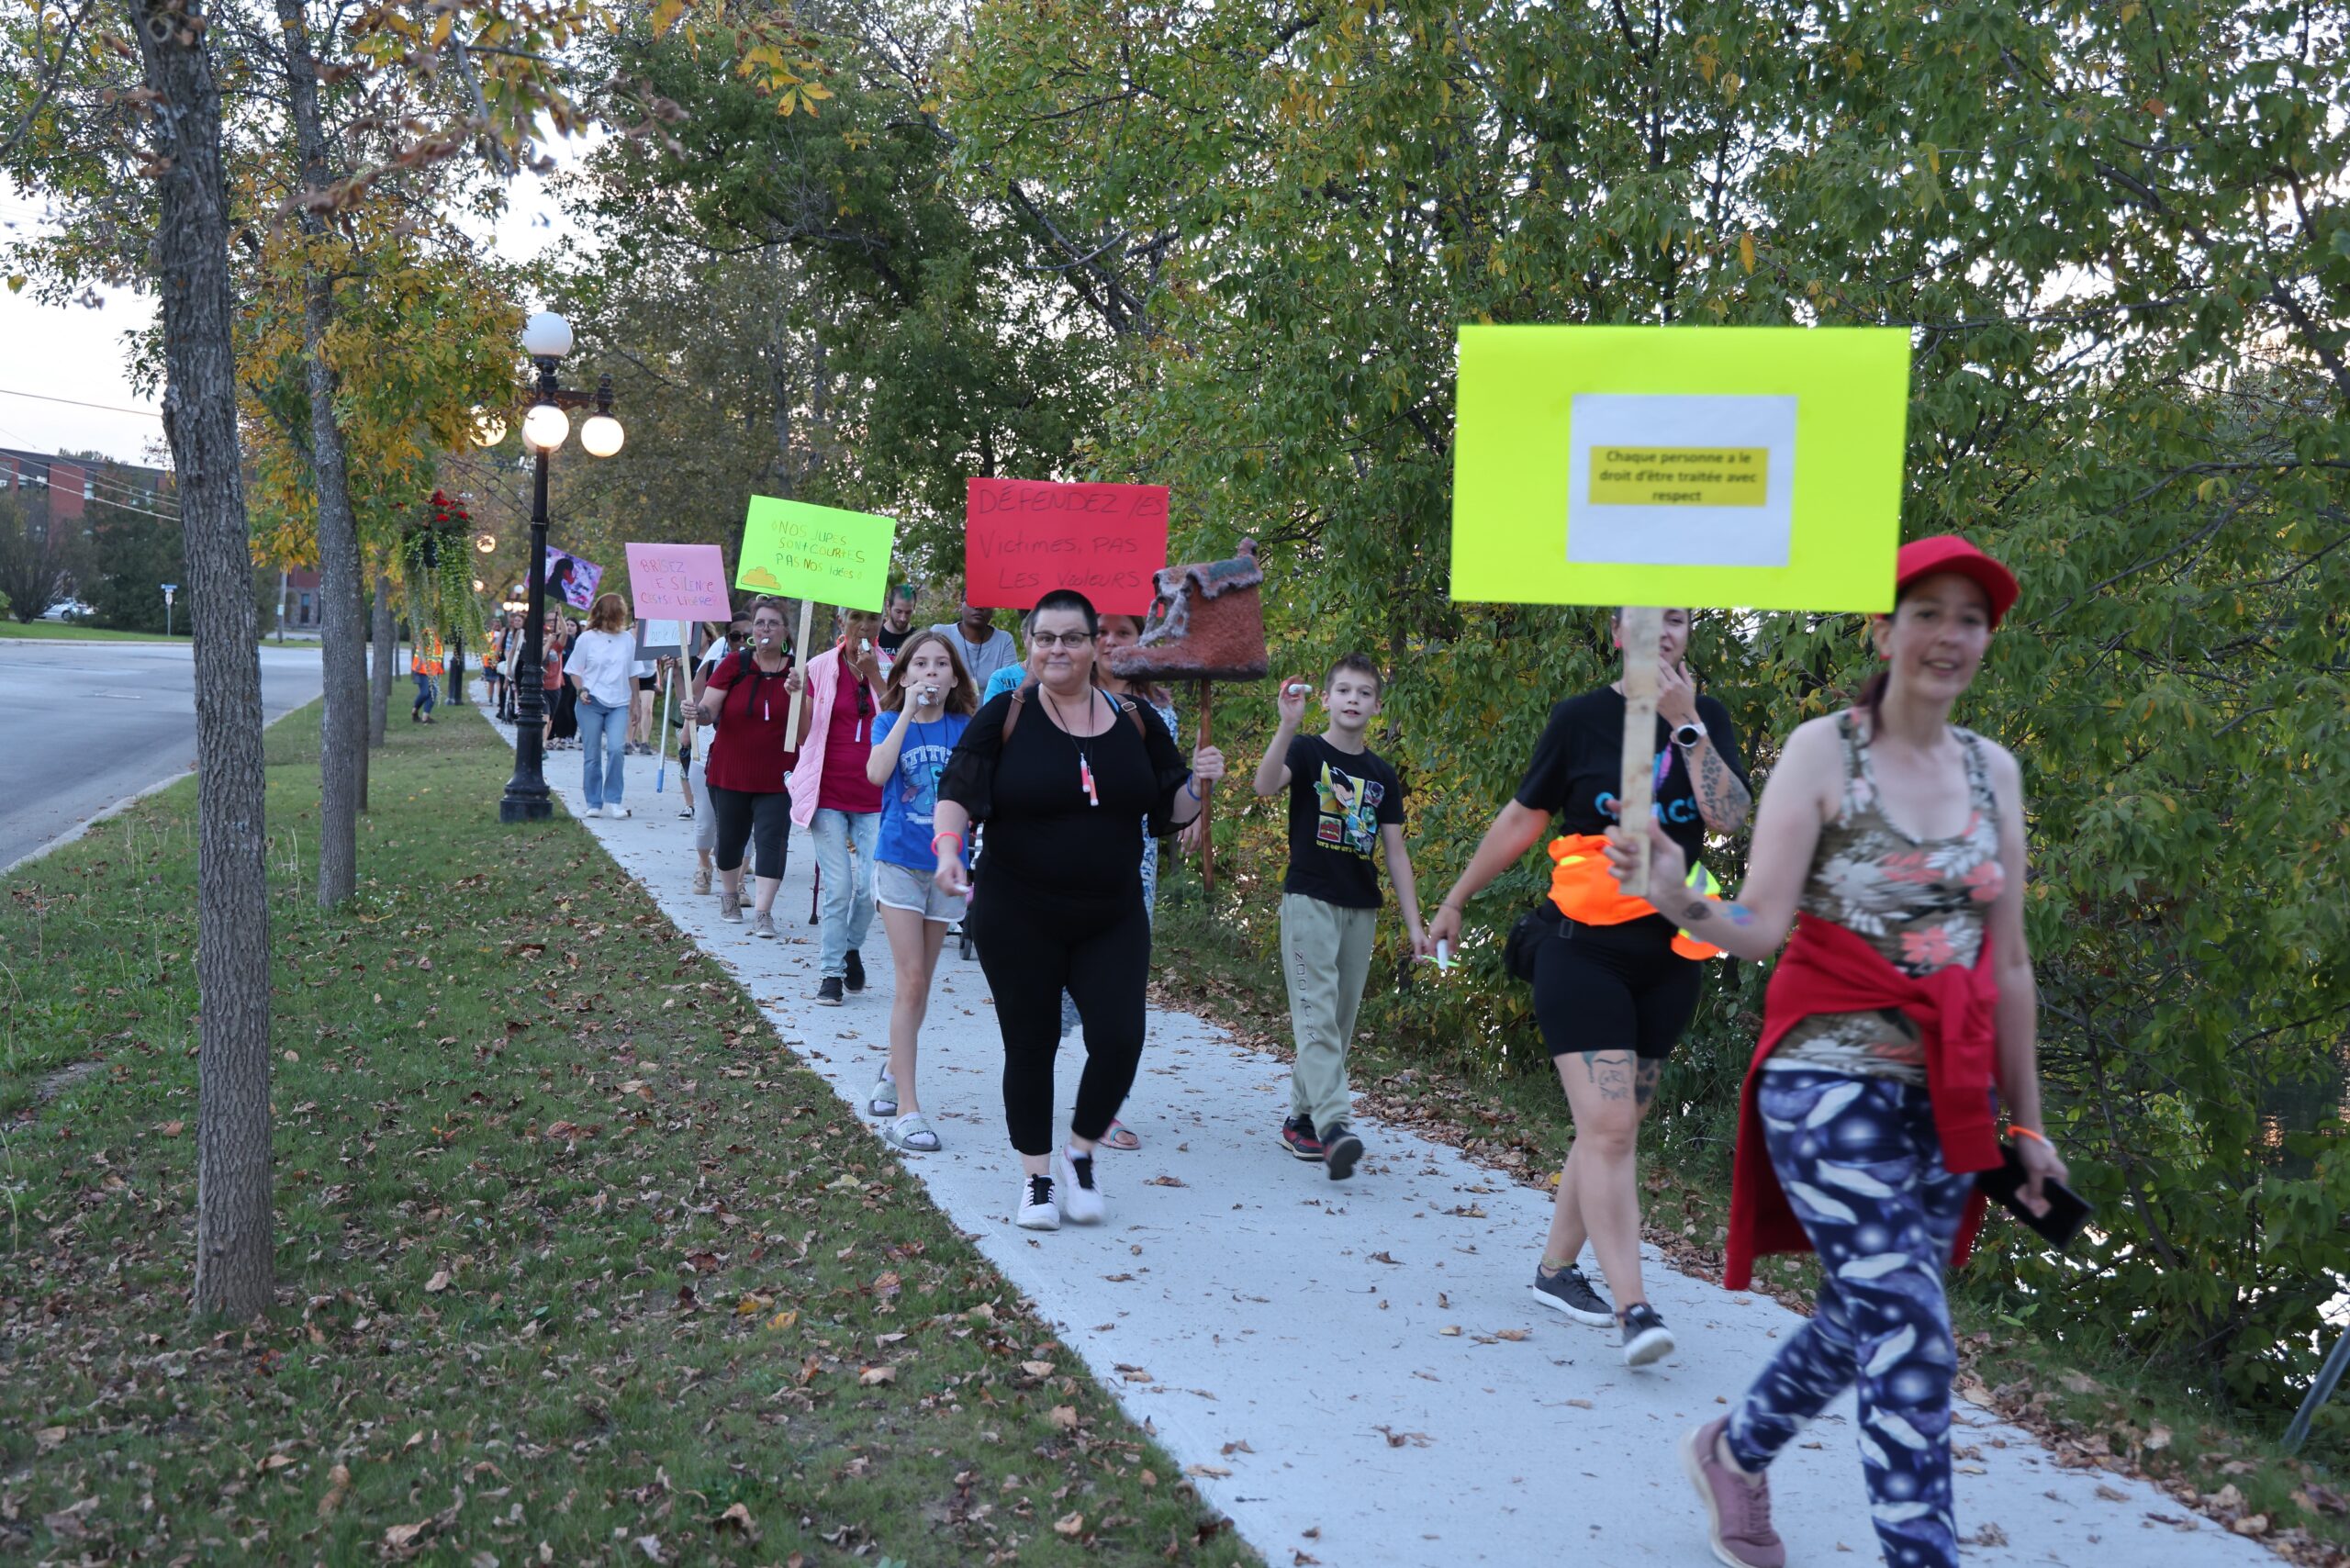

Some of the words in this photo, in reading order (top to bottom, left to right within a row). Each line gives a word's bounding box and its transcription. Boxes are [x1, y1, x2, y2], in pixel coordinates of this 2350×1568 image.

[1606, 450, 1657, 464] Chaque
[1660, 452, 1723, 465] personne
[1727, 454, 1736, 464] a
[1739, 451, 1751, 464] le
[1599, 470, 1631, 482] droit
[1678, 471, 1723, 483] traitée
[1727, 473, 1757, 483] avec
[1652, 490, 1702, 503] respect
[778, 521, 808, 538] NOS
[810, 529, 847, 546] JUPES
[1092, 536, 1138, 554] PAS
[775, 553, 800, 567] PAS
[803, 557, 823, 572] NOS
[998, 566, 1041, 589] LES
[900, 745, 953, 769] STITC
